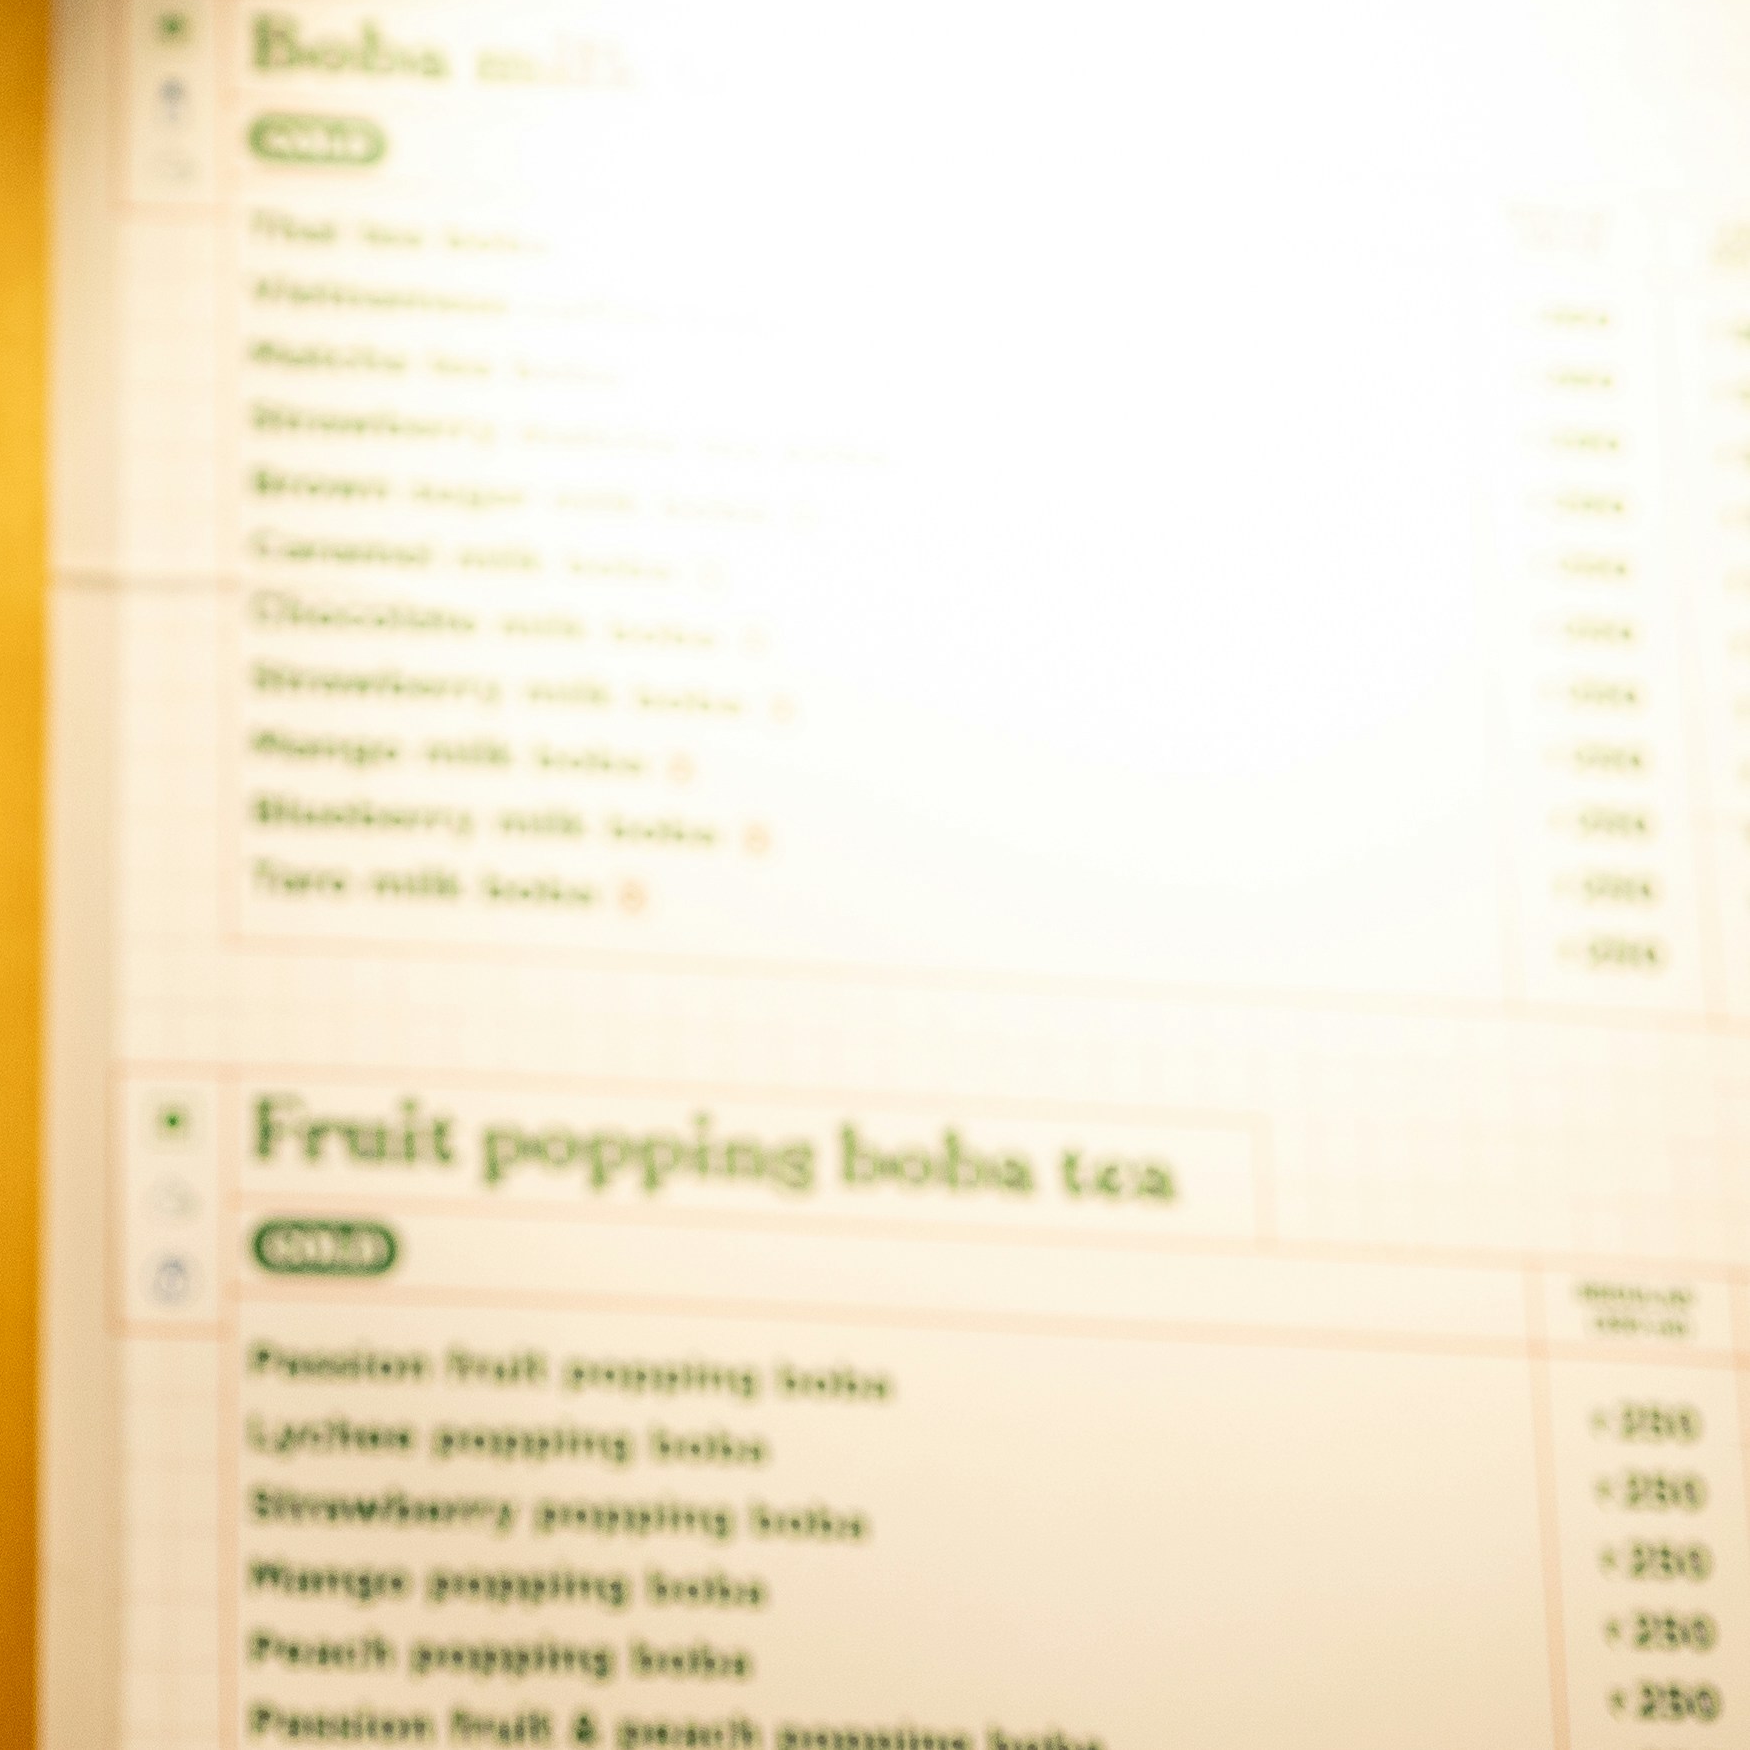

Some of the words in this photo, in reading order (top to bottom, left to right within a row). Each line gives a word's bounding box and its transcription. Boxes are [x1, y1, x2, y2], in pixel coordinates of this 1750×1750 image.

[248, 12, 452, 79] Boba
[252, 1094, 455, 1167] Fruit
[479, 1114, 816, 1197] popping
[837, 1123, 1037, 1198] boba
[1059, 1151, 1177, 1205] tea
[561, 1359, 761, 1402] popping
[774, 1365, 893, 1402] boba
[429, 1424, 634, 1467] popping
[648, 1428, 769, 1466] boba
[532, 1499, 736, 1543] popping
[748, 1504, 869, 1542] boba
[425, 1568, 631, 1611] popping
[645, 1570, 768, 1610] boba
[409, 1641, 616, 1684] popping
[629, 1641, 753, 1681] boba
